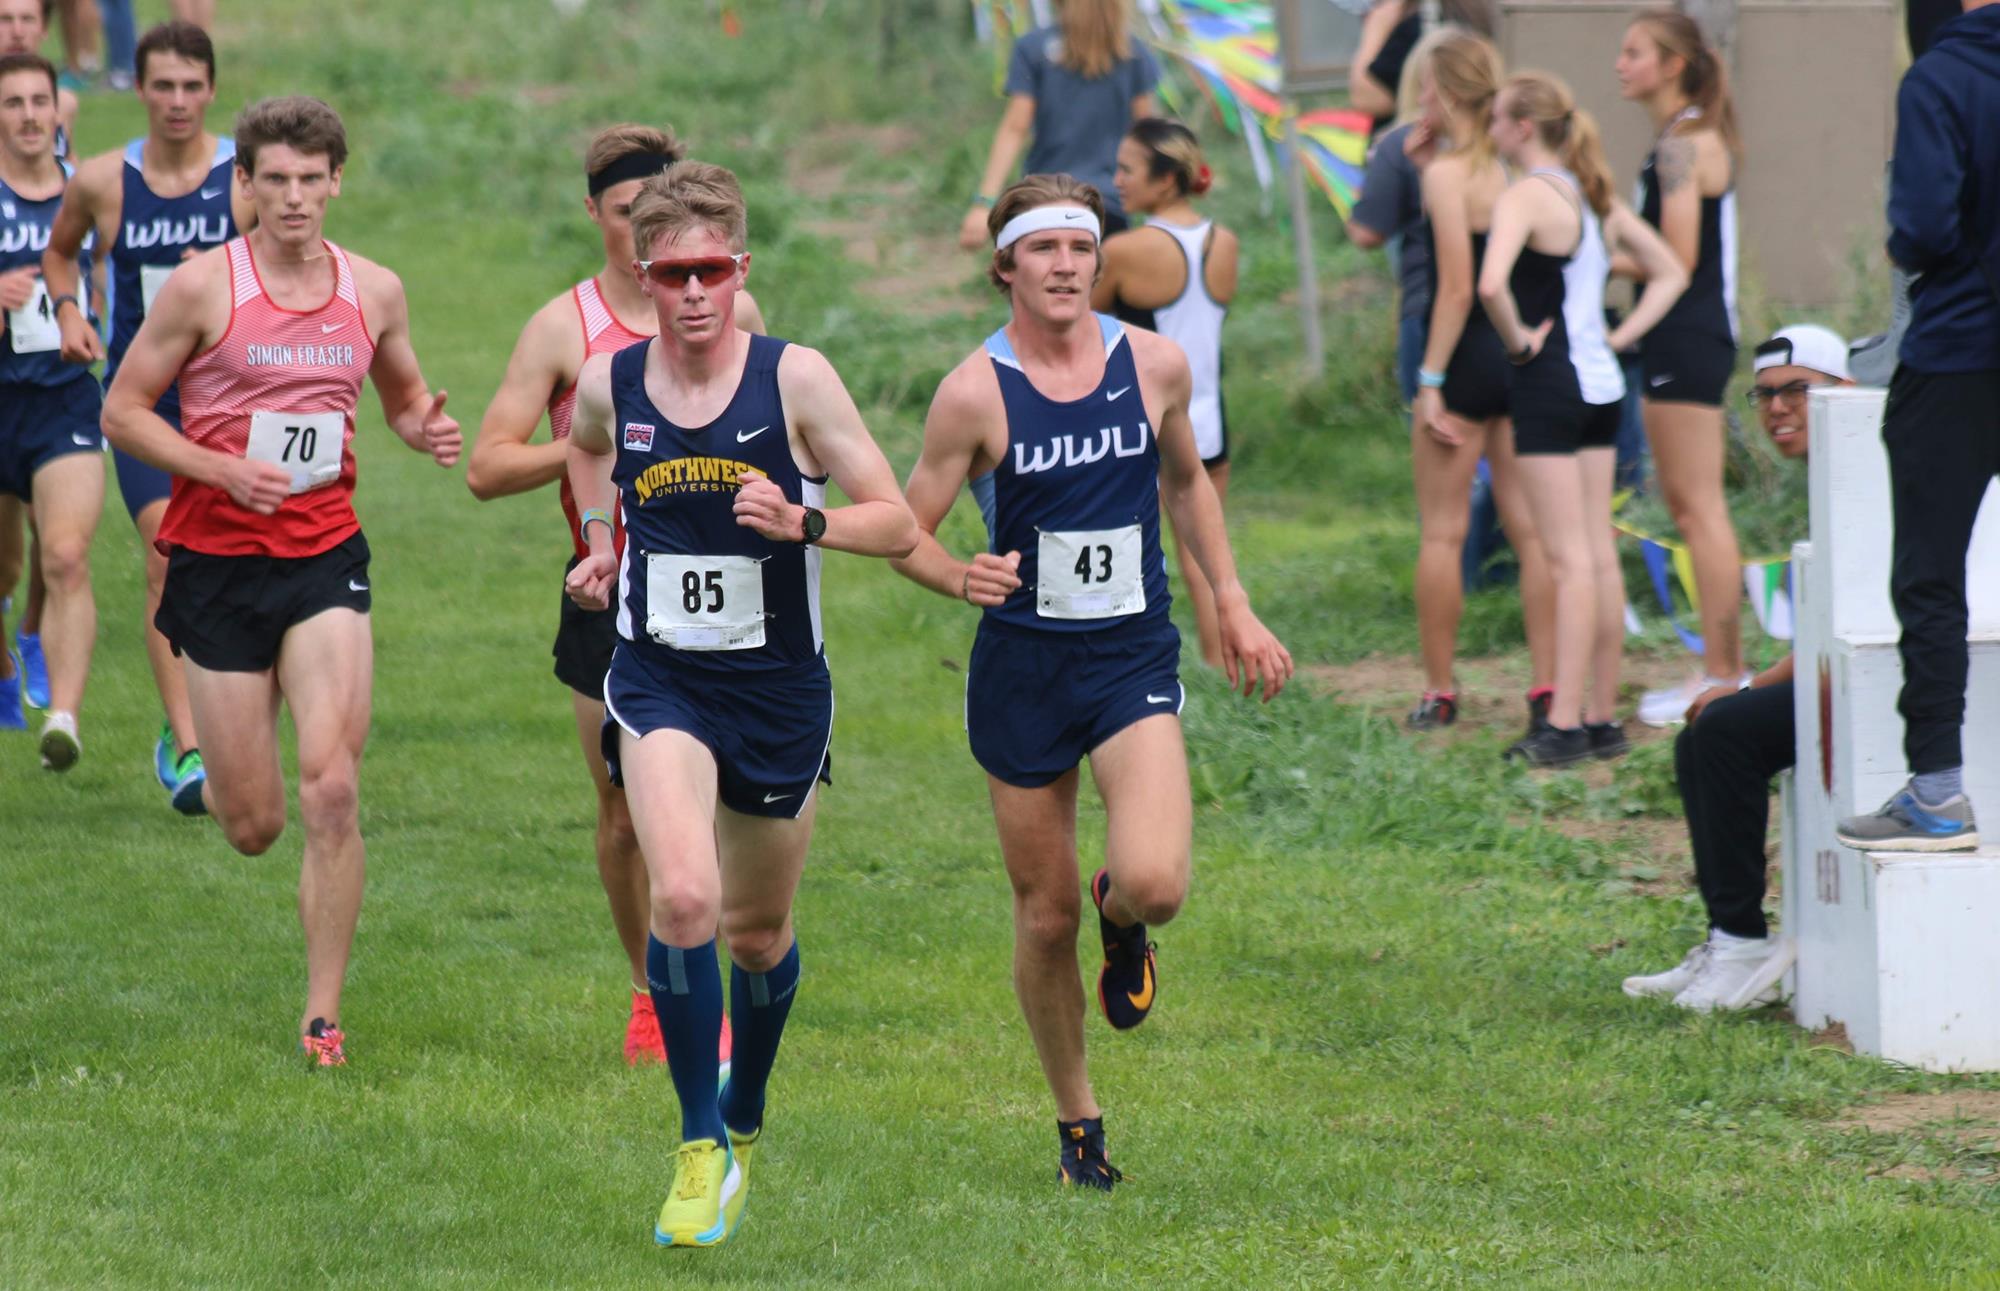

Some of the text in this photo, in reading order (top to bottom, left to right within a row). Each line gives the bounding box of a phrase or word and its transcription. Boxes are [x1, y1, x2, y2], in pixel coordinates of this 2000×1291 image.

[126, 216, 228, 249] WWU
[247, 344, 353, 365] SIMON FRASER
[281, 426, 317, 462] 70
[1014, 422, 1148, 475] WWU
[656, 482, 742, 498] UNIVERSIT
[1074, 544, 1113, 584] 43
[682, 570, 725, 614] 85
